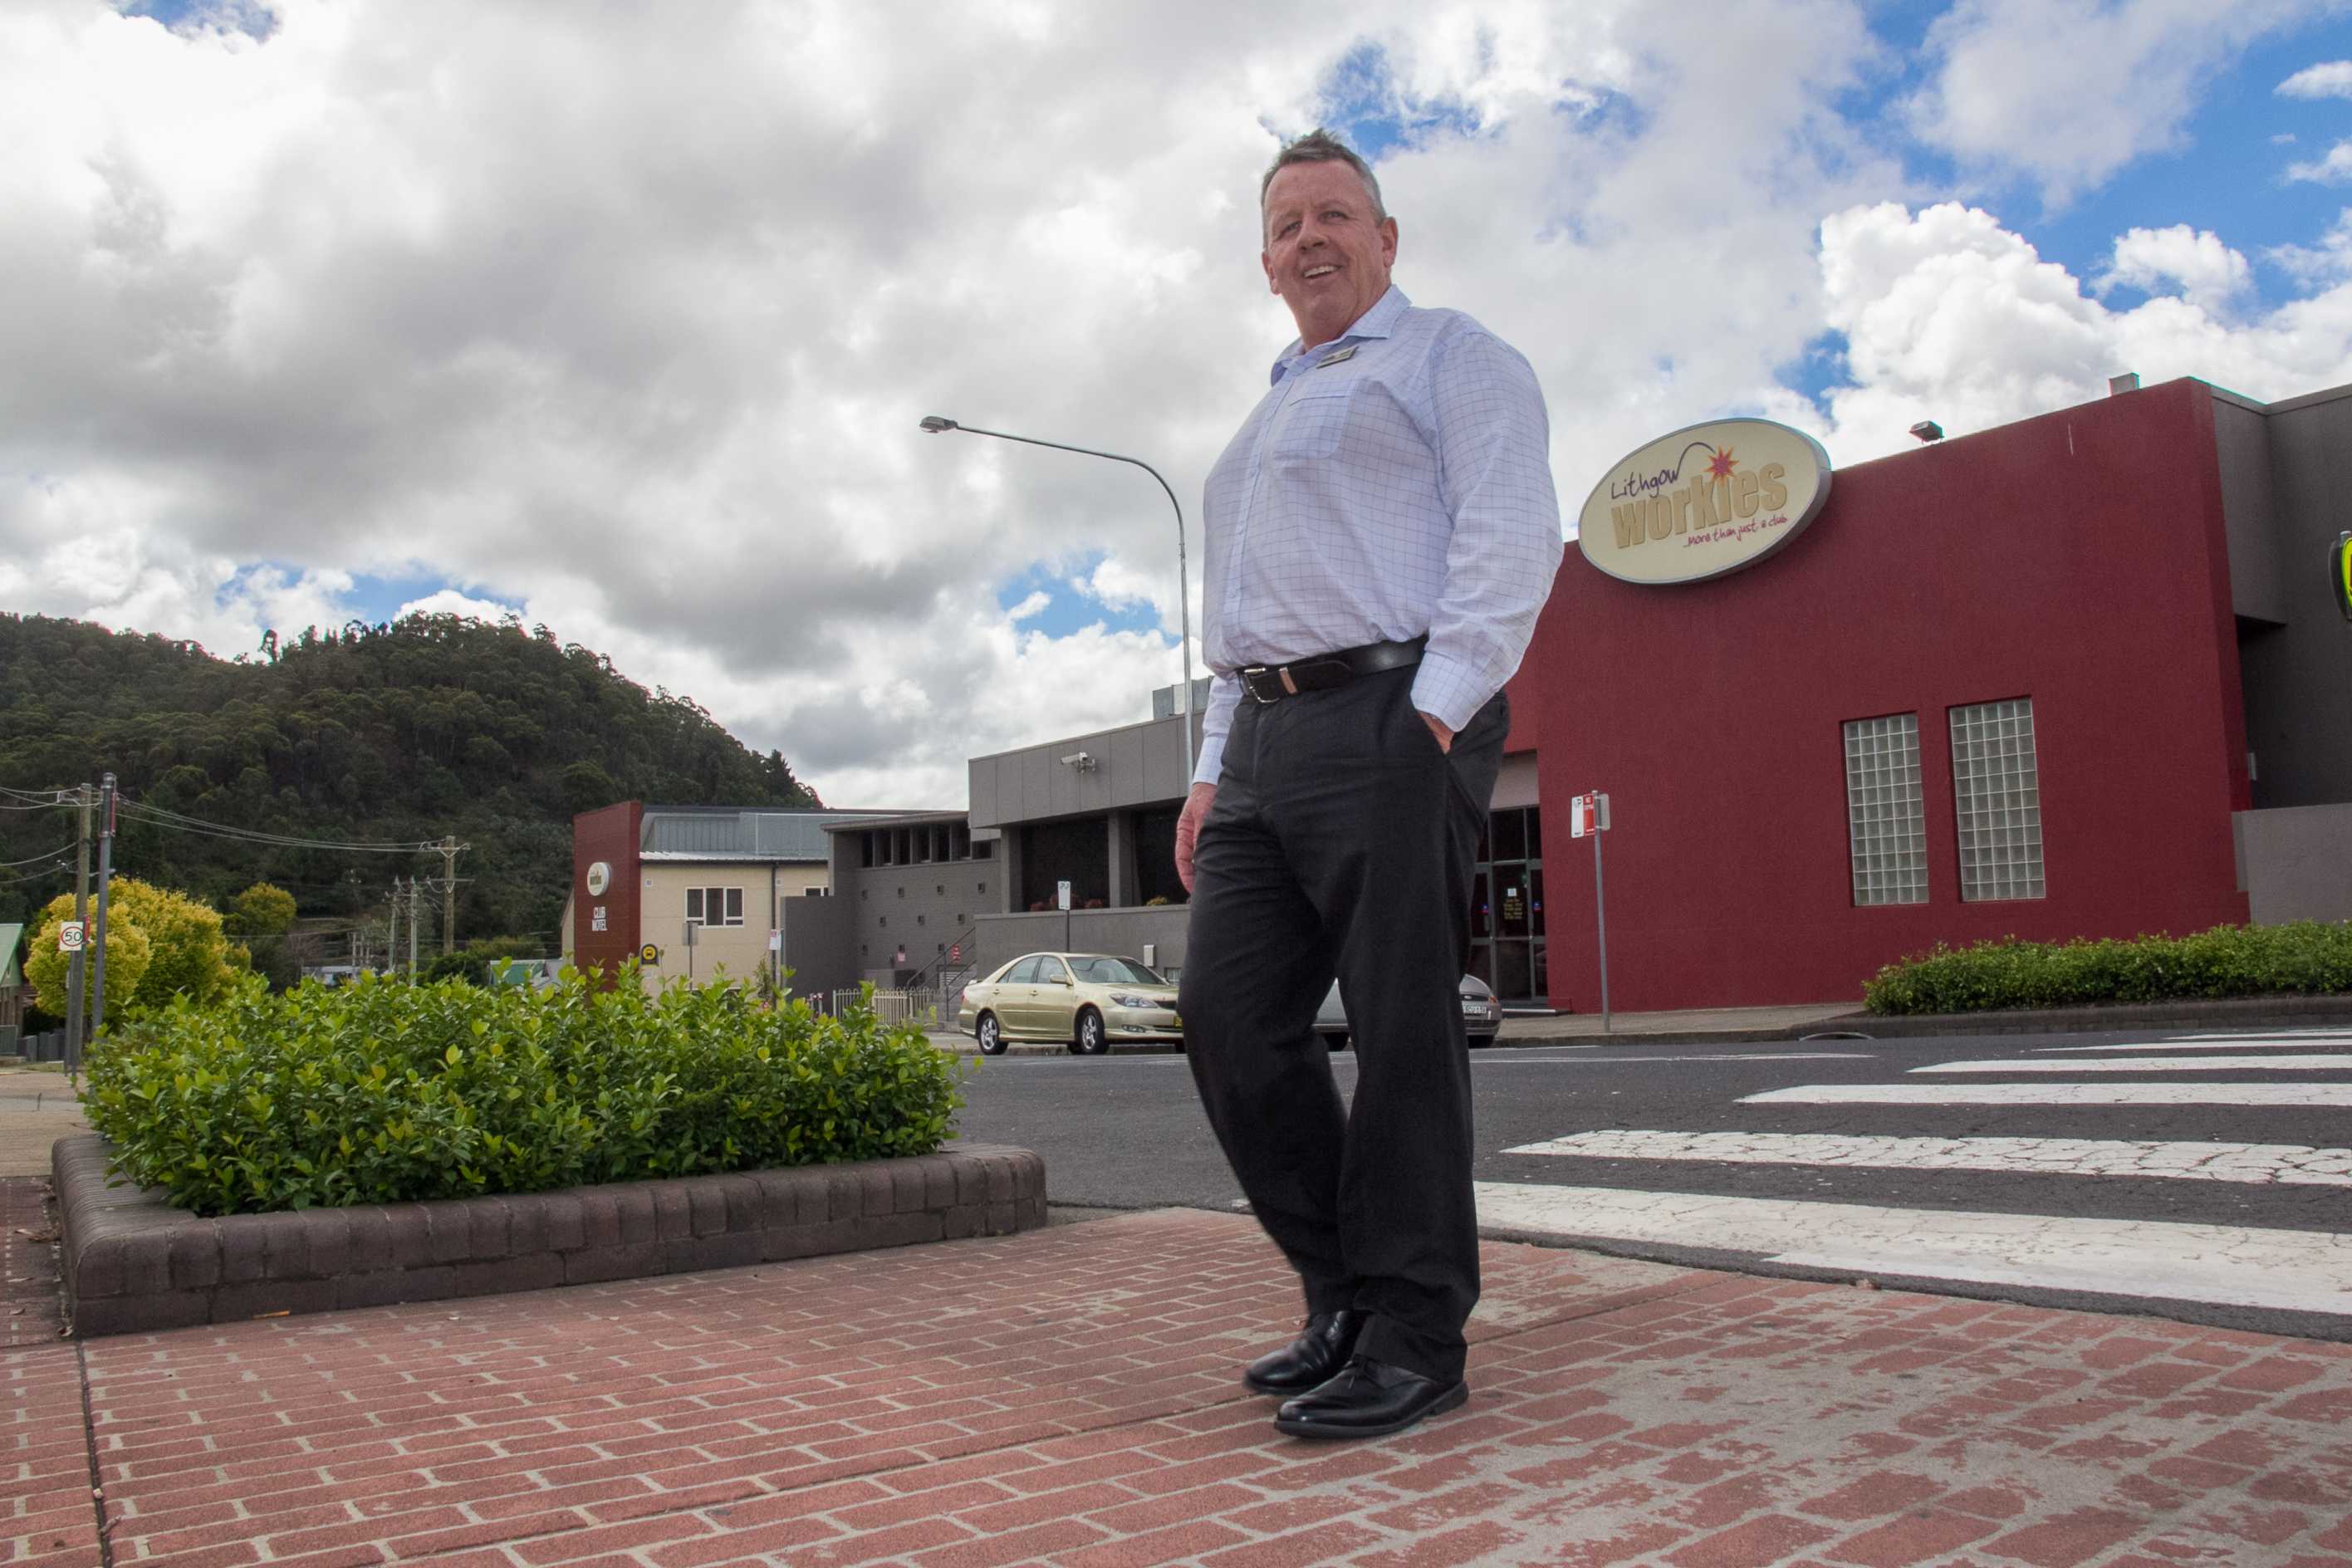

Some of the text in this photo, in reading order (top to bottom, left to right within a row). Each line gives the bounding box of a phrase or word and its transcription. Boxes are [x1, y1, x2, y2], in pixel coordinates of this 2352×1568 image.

[1611, 469, 1680, 500] Lithgow
[1713, 527, 1737, 542] than
[1735, 517, 1756, 542] just
[1768, 513, 1788, 527] club
[65, 931, 82, 942] 50
